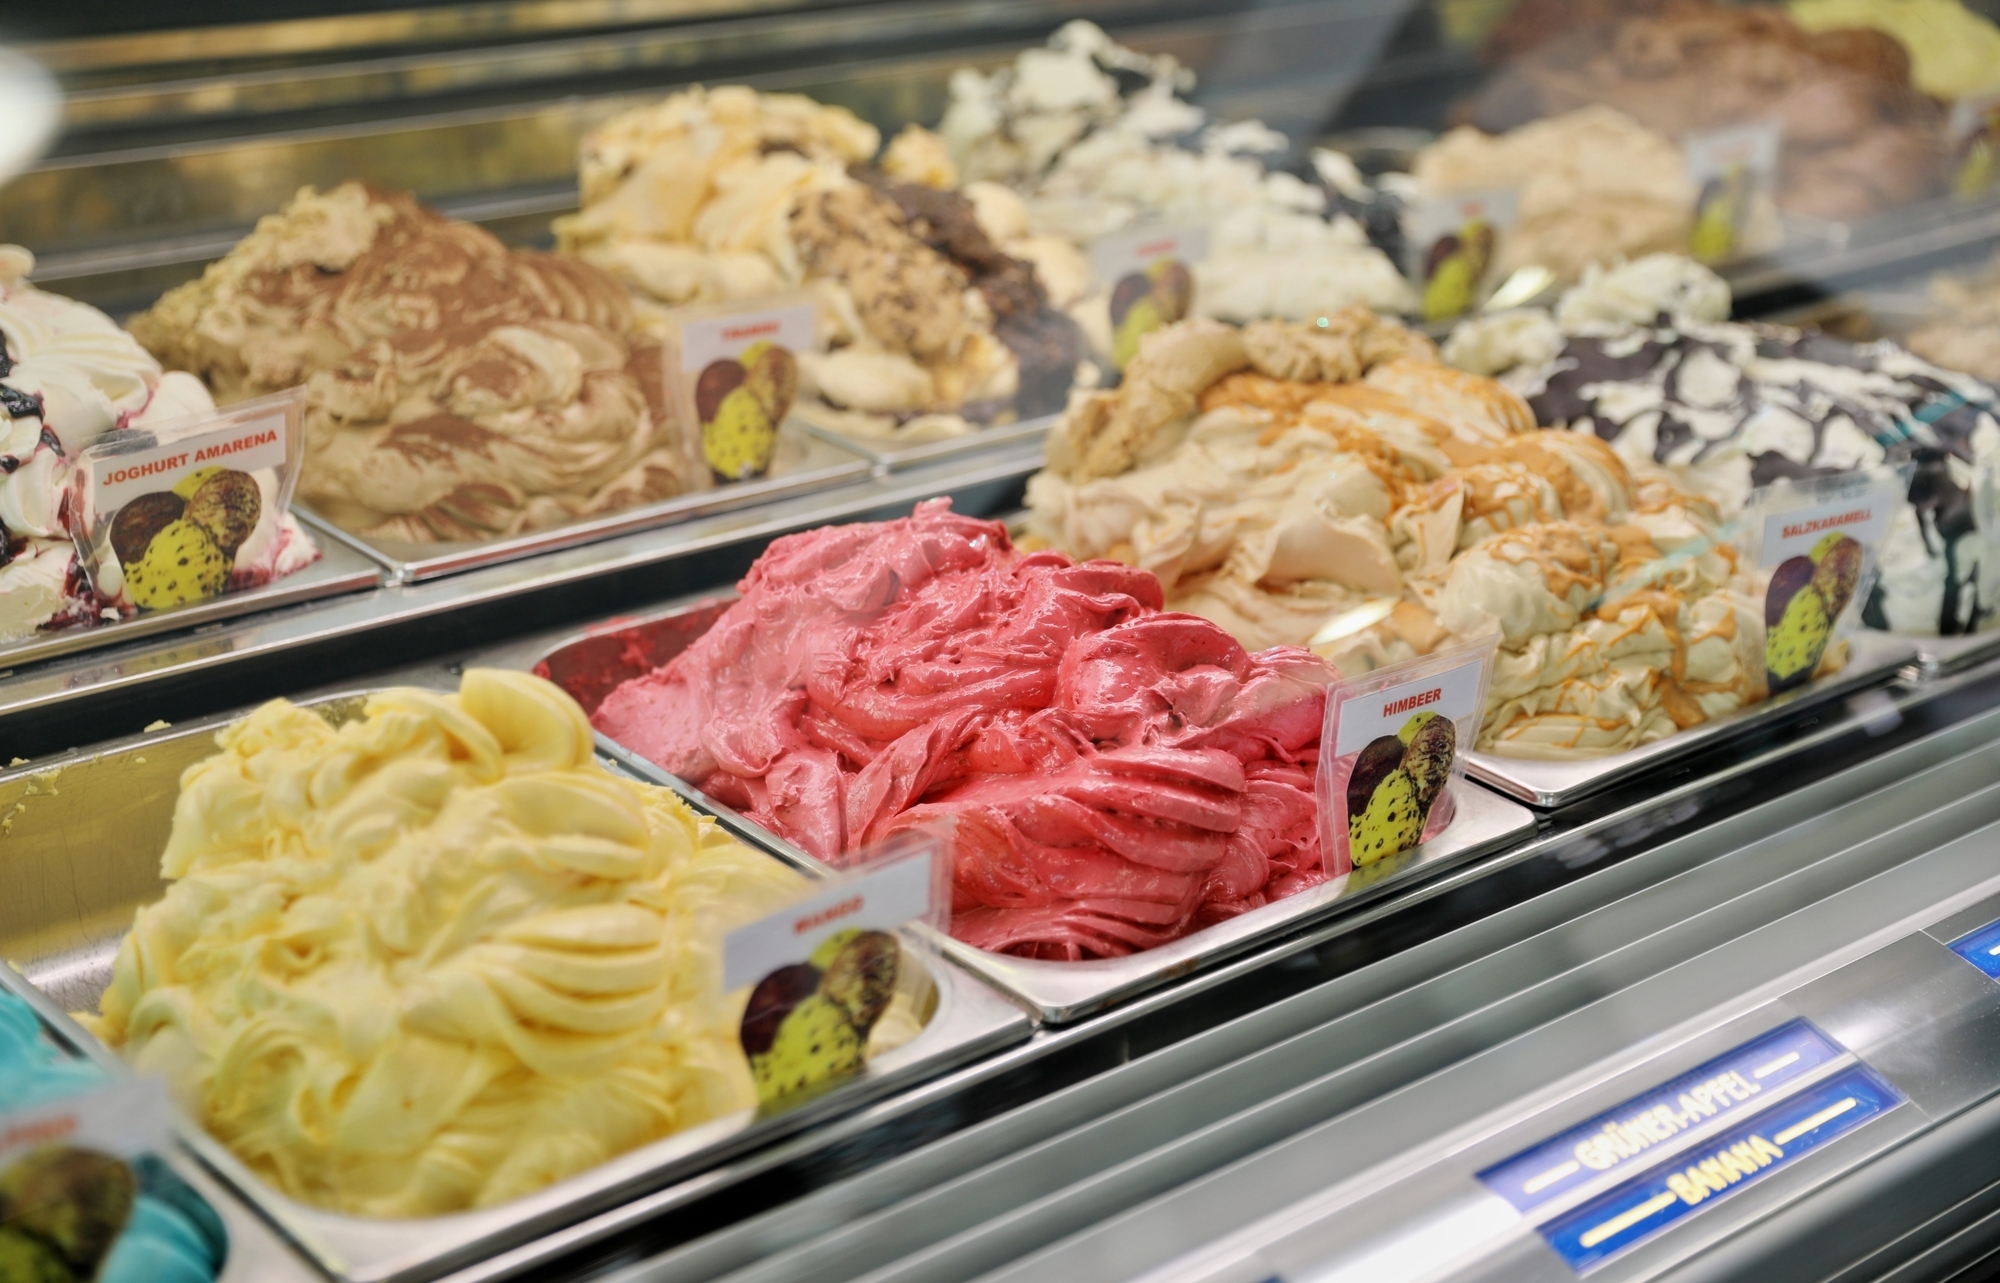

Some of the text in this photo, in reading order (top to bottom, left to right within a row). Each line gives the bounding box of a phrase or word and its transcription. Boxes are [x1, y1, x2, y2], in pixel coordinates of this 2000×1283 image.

[102, 429, 278, 486] JOGHURT AMARENA
[1781, 507, 1873, 539] SALZKARAMELL
[1382, 687, 1442, 718] HIMBEER
[1574, 1069, 1762, 1170] GRÜNER-APFEL
[1666, 1134, 1783, 1205] BANANA
